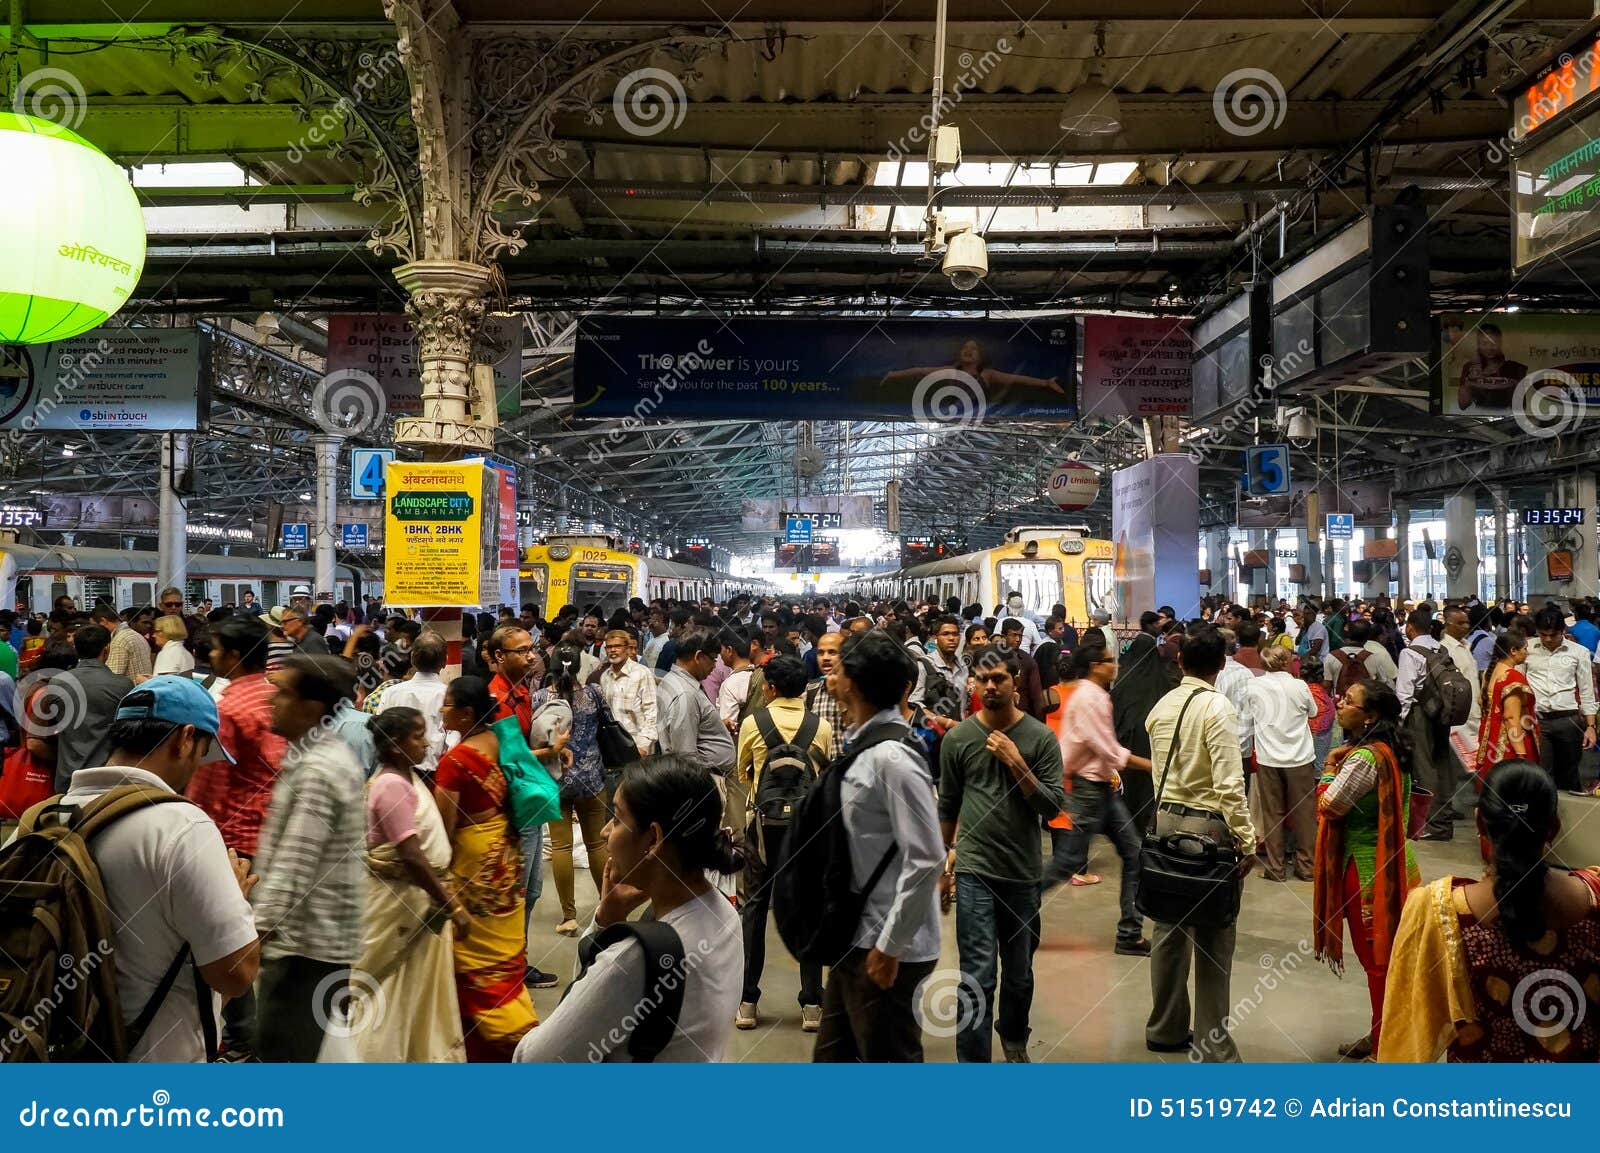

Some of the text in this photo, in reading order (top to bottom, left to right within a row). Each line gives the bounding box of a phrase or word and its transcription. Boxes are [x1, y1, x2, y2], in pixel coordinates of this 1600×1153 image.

[375, 322, 397, 332] We
[348, 336, 375, 346] Our
[128, 347, 189, 355] ready-to-use
[738, 355, 750, 371] is
[755, 357, 800, 376] yours
[677, 381, 698, 393] you
[700, 379, 714, 390] for
[717, 379, 735, 390] the
[736, 380, 759, 391] past
[762, 379, 787, 391] 100
[360, 454, 386, 494] 4
[1258, 450, 1283, 491] 5
[395, 497, 470, 507] LANDSCAPE CITY
[436, 525, 462, 534] 2BHK
[582, 550, 607, 560] 1025
[551, 578, 567, 586] 1025
